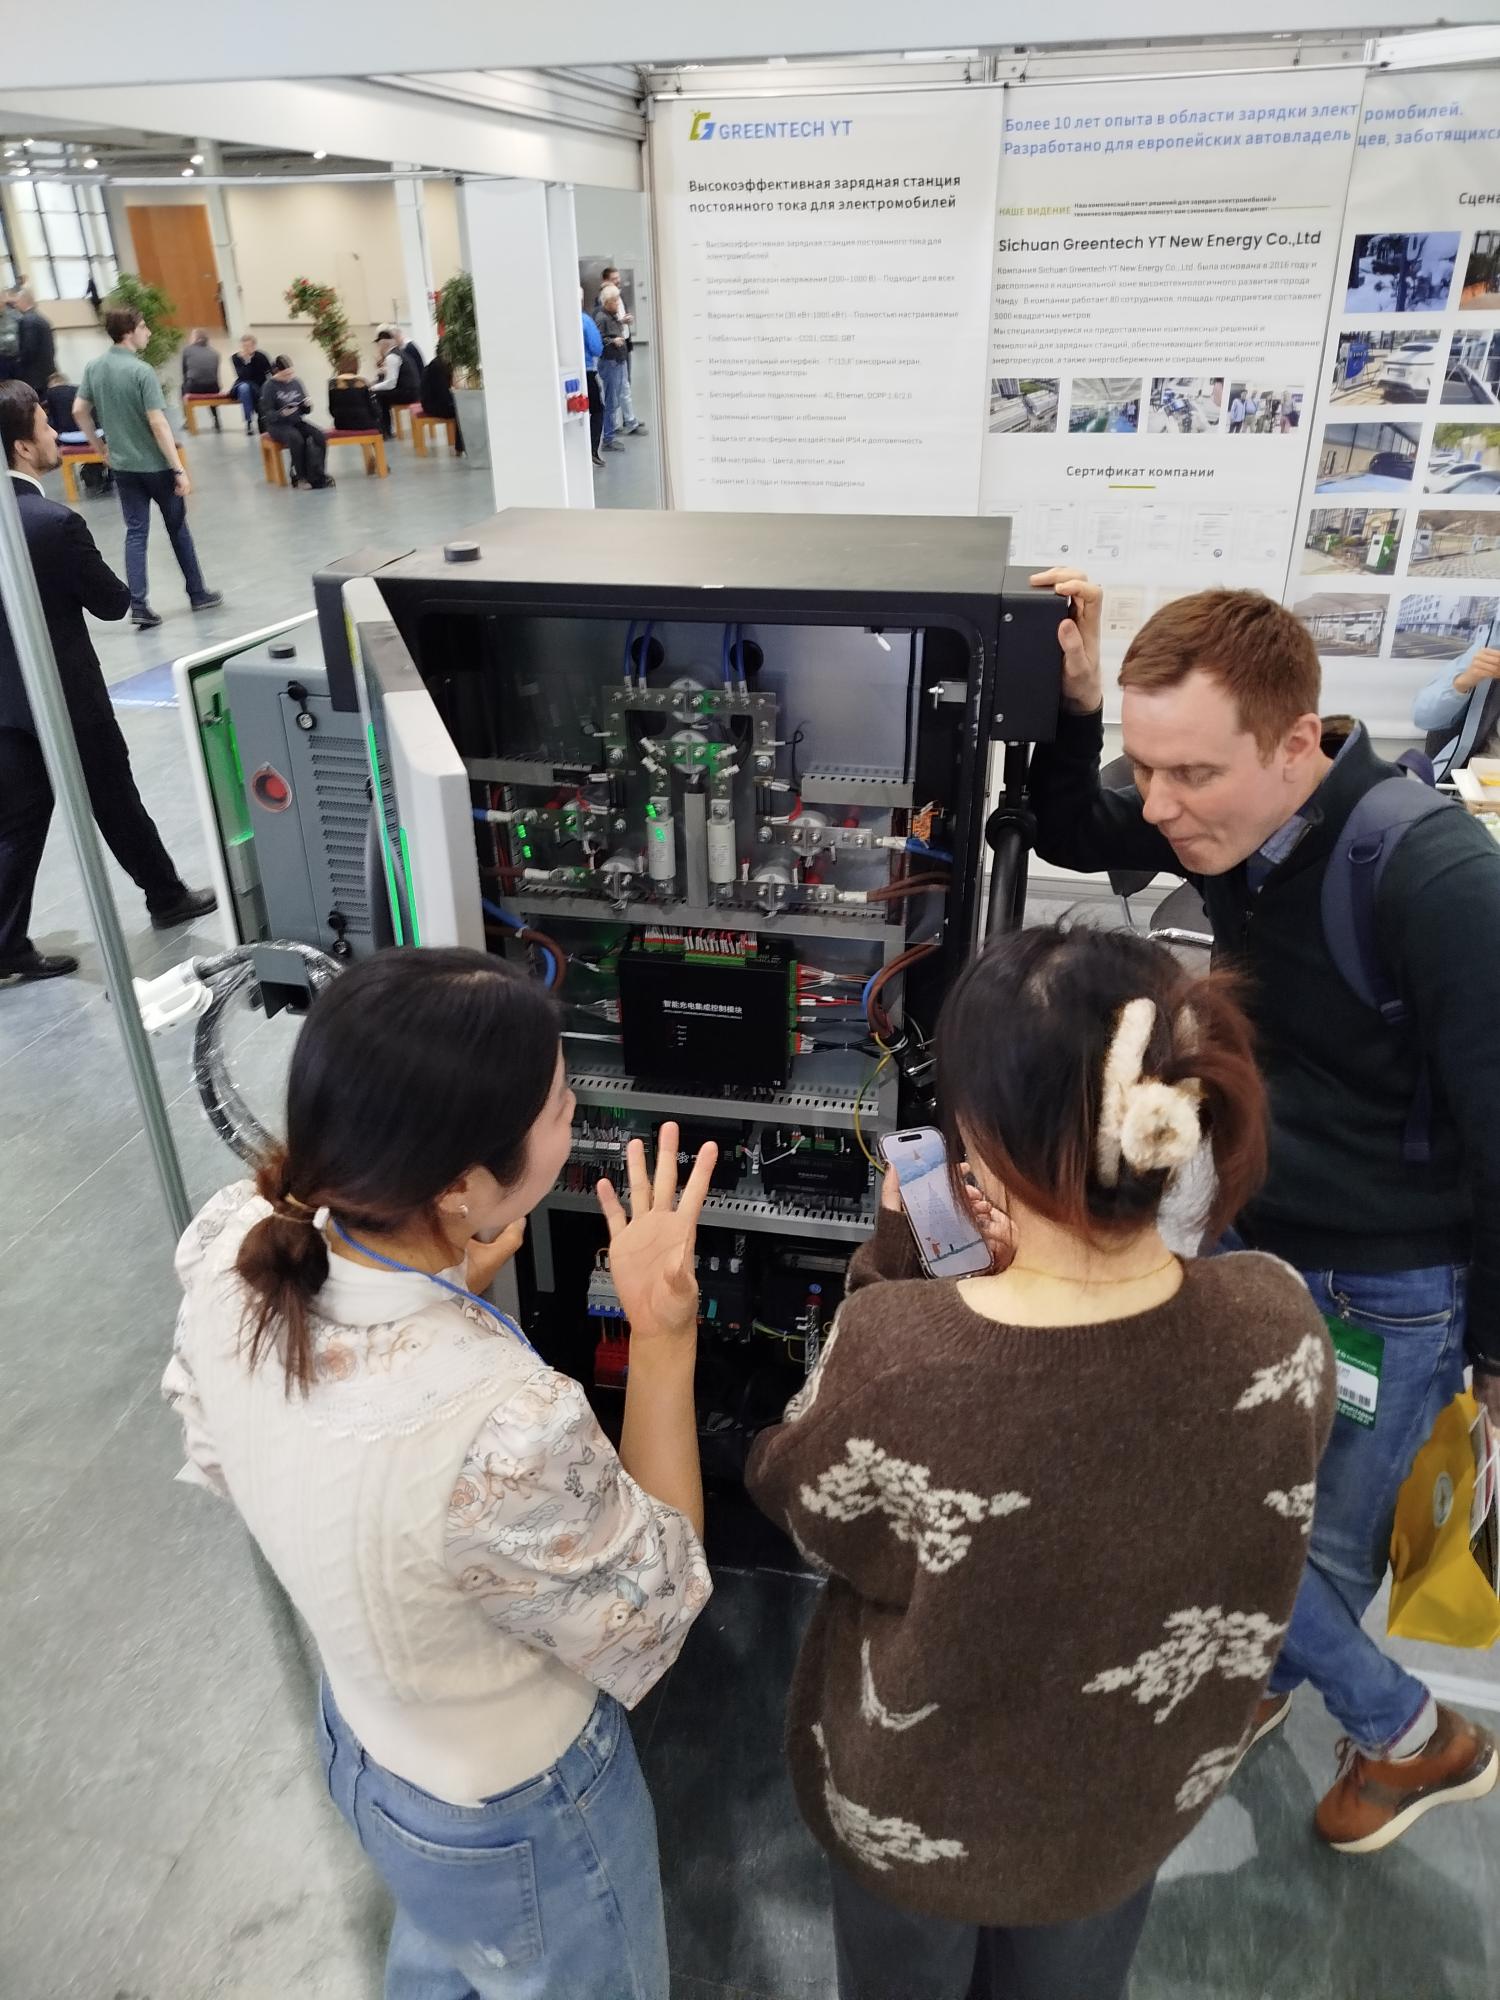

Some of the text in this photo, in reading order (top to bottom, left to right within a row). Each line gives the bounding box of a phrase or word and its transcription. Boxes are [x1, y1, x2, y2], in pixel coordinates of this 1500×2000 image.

[1005, 117, 1050, 132] Более
[1054, 115, 1071, 130] 10
[1074, 116, 1099, 129] лет
[1104, 114, 1152, 128] опыта
[1156, 115, 1165, 125] в
[1169, 109, 1234, 124] области
[1239, 105, 1306, 123] зарядки
[719, 119, 853, 141] GREENTECH YT
[1004, 139, 1101, 157] Разработано
[1104, 138, 1133, 154] для
[1138, 132, 1241, 153] европейских
[689, 175, 961, 194] Высокоэффективная зарядная станция
[689, 195, 956, 214] постоянного тока для электромобилей
[999, 206, 1071, 217] НАШЕ ВИДЕНИЕ
[999, 231, 1321, 252] Sichuan Greentech YT New Energy Co.,Ltd
[1119, 264, 1136, 272] New
[1138, 263, 1164, 274] Energy
[1066, 465, 1215, 478] Сертификат компании
